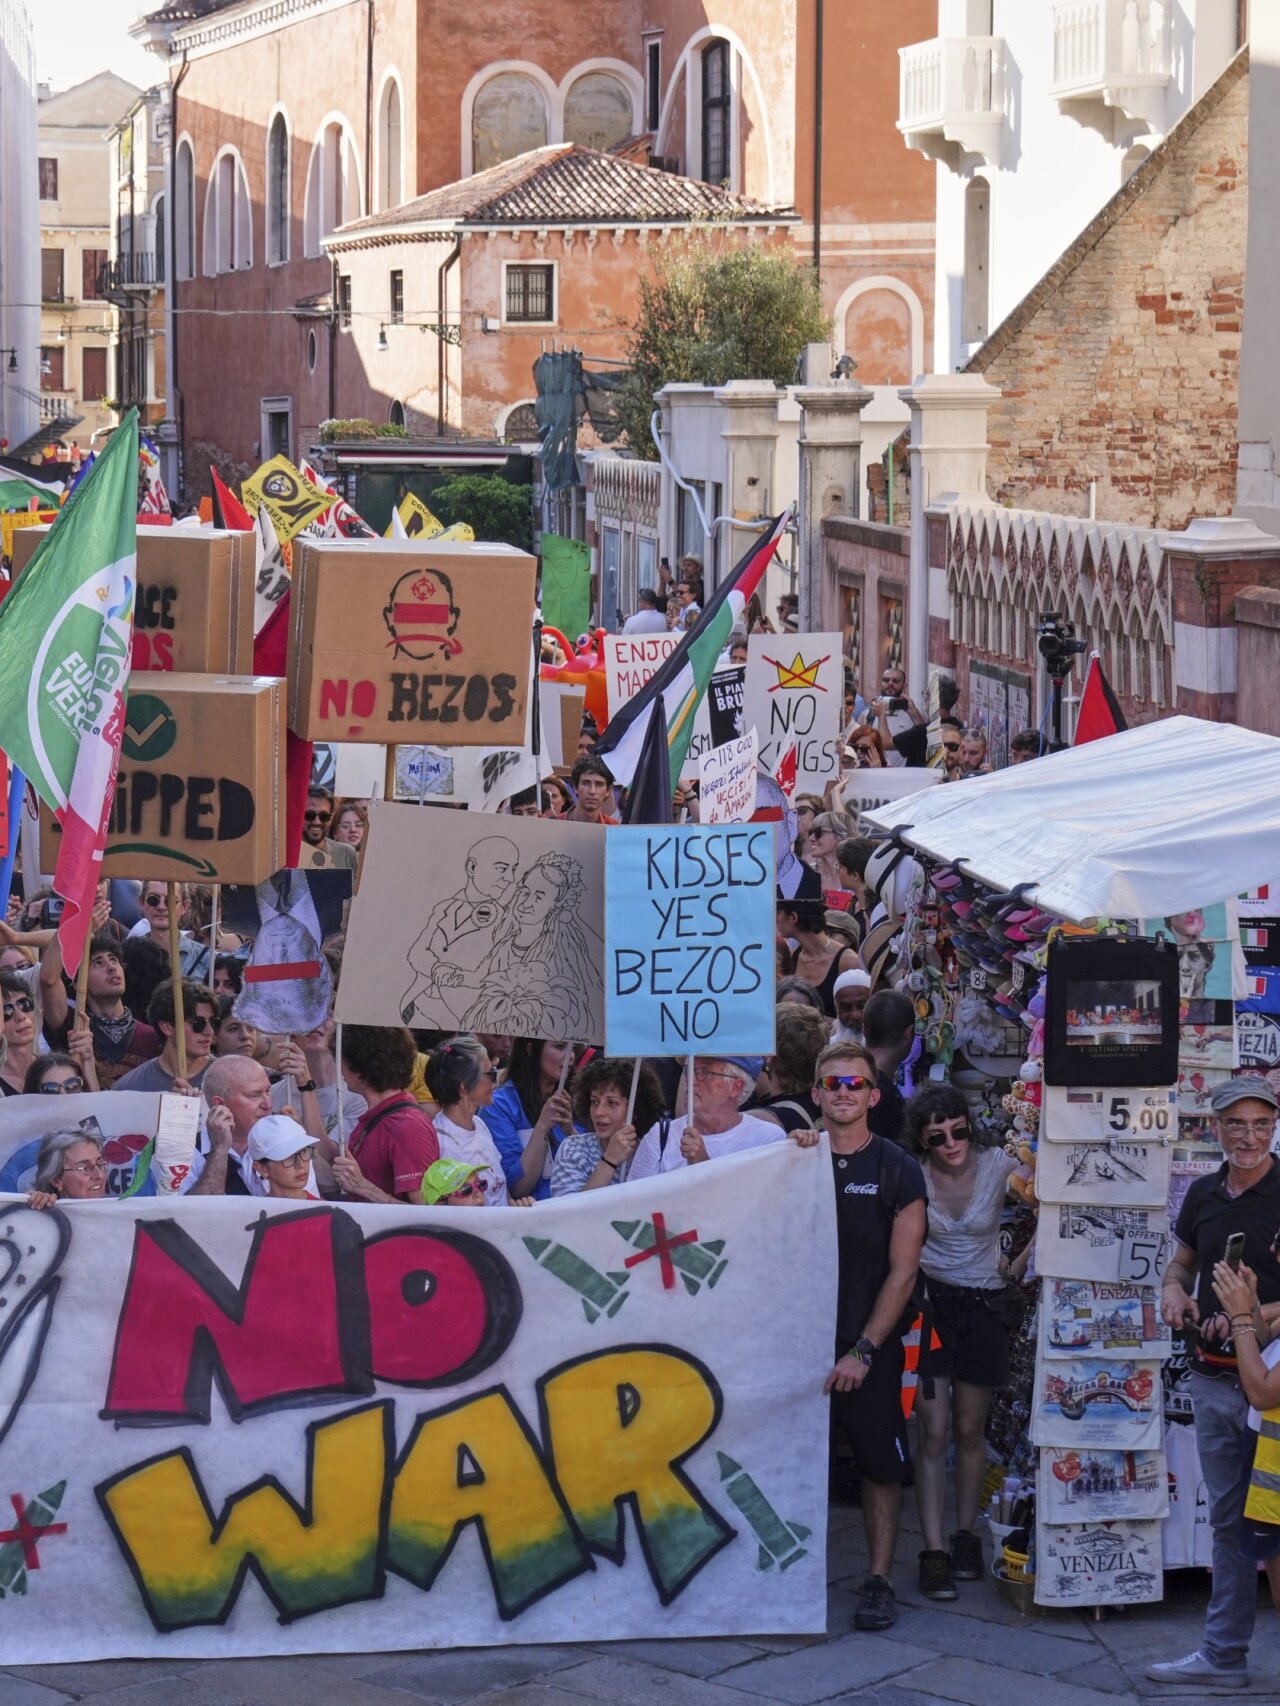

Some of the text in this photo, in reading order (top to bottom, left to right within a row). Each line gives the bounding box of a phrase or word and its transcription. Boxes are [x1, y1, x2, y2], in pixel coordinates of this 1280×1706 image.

[615, 639, 676, 664] ENJO
[319, 672, 517, 723] NO BEZOS
[770, 694, 817, 736] NO
[647, 830, 767, 890] KISSES
[651, 892, 728, 940] YES
[614, 943, 763, 996] BEZOS
[660, 998, 720, 1043] NO
[1109, 1097, 1169, 1134] 5,00
[1091, 1280, 1140, 1300] VENEZIA
[99, 1204, 524, 1427] NO
[92, 1341, 739, 1634] WAR
[1060, 1551, 1138, 1573] VENEZIA
